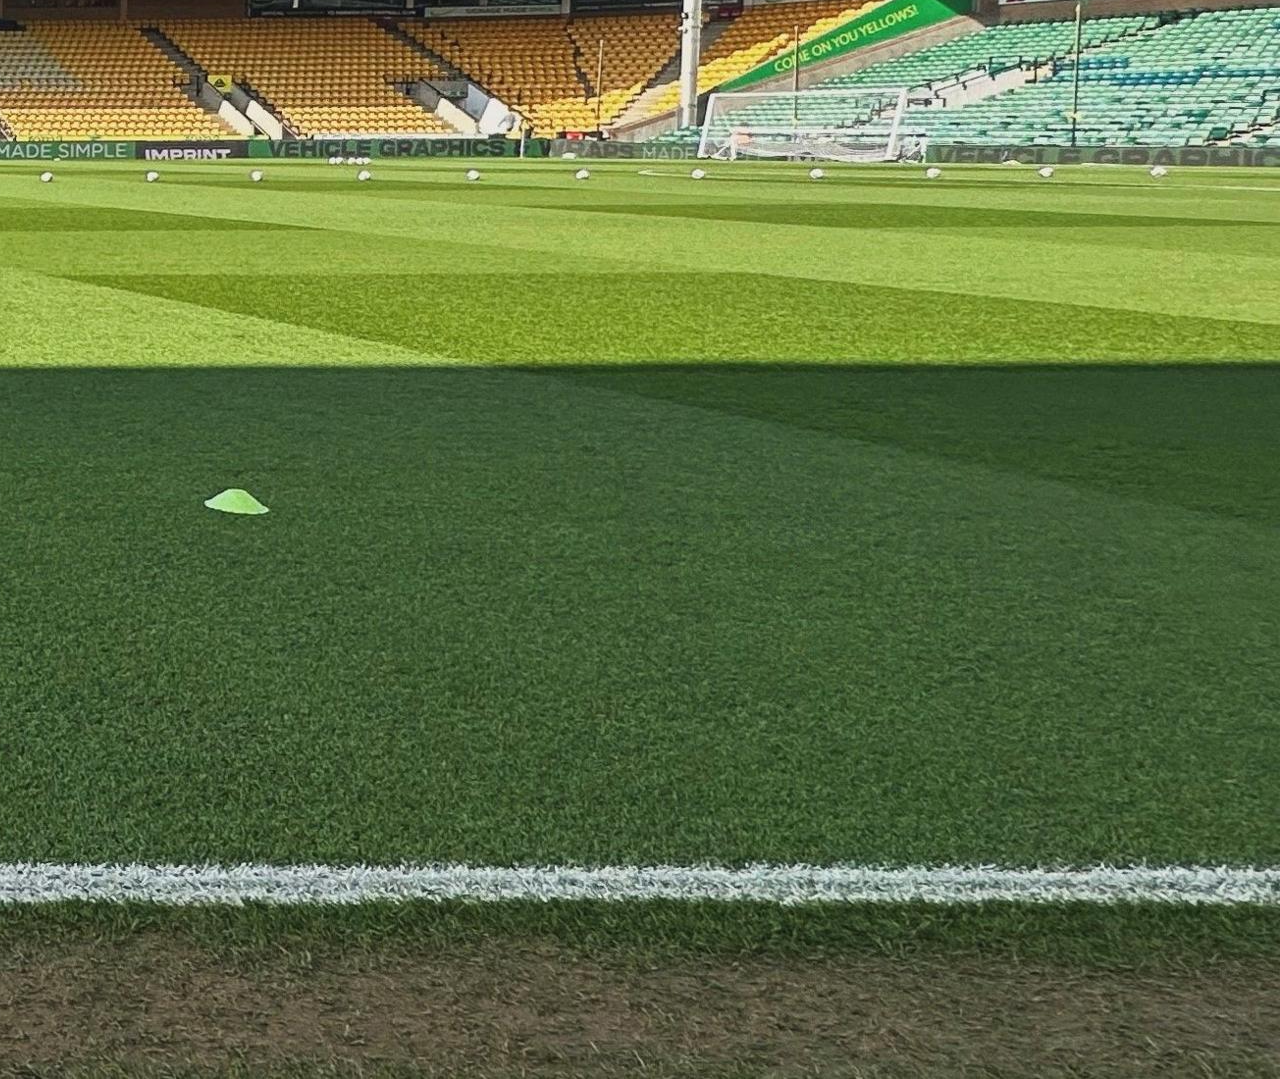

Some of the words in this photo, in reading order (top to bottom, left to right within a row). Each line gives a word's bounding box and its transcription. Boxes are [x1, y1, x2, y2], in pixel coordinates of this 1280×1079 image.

[811, 39, 833, 57] ON
[831, 29, 859, 49] YOU
[857, 4, 919, 37] YELLOWS!
[57, 143, 128, 158] SIMPLE
[268, 139, 372, 157] VEHICLE
[378, 139, 506, 157] GRAPHICS
